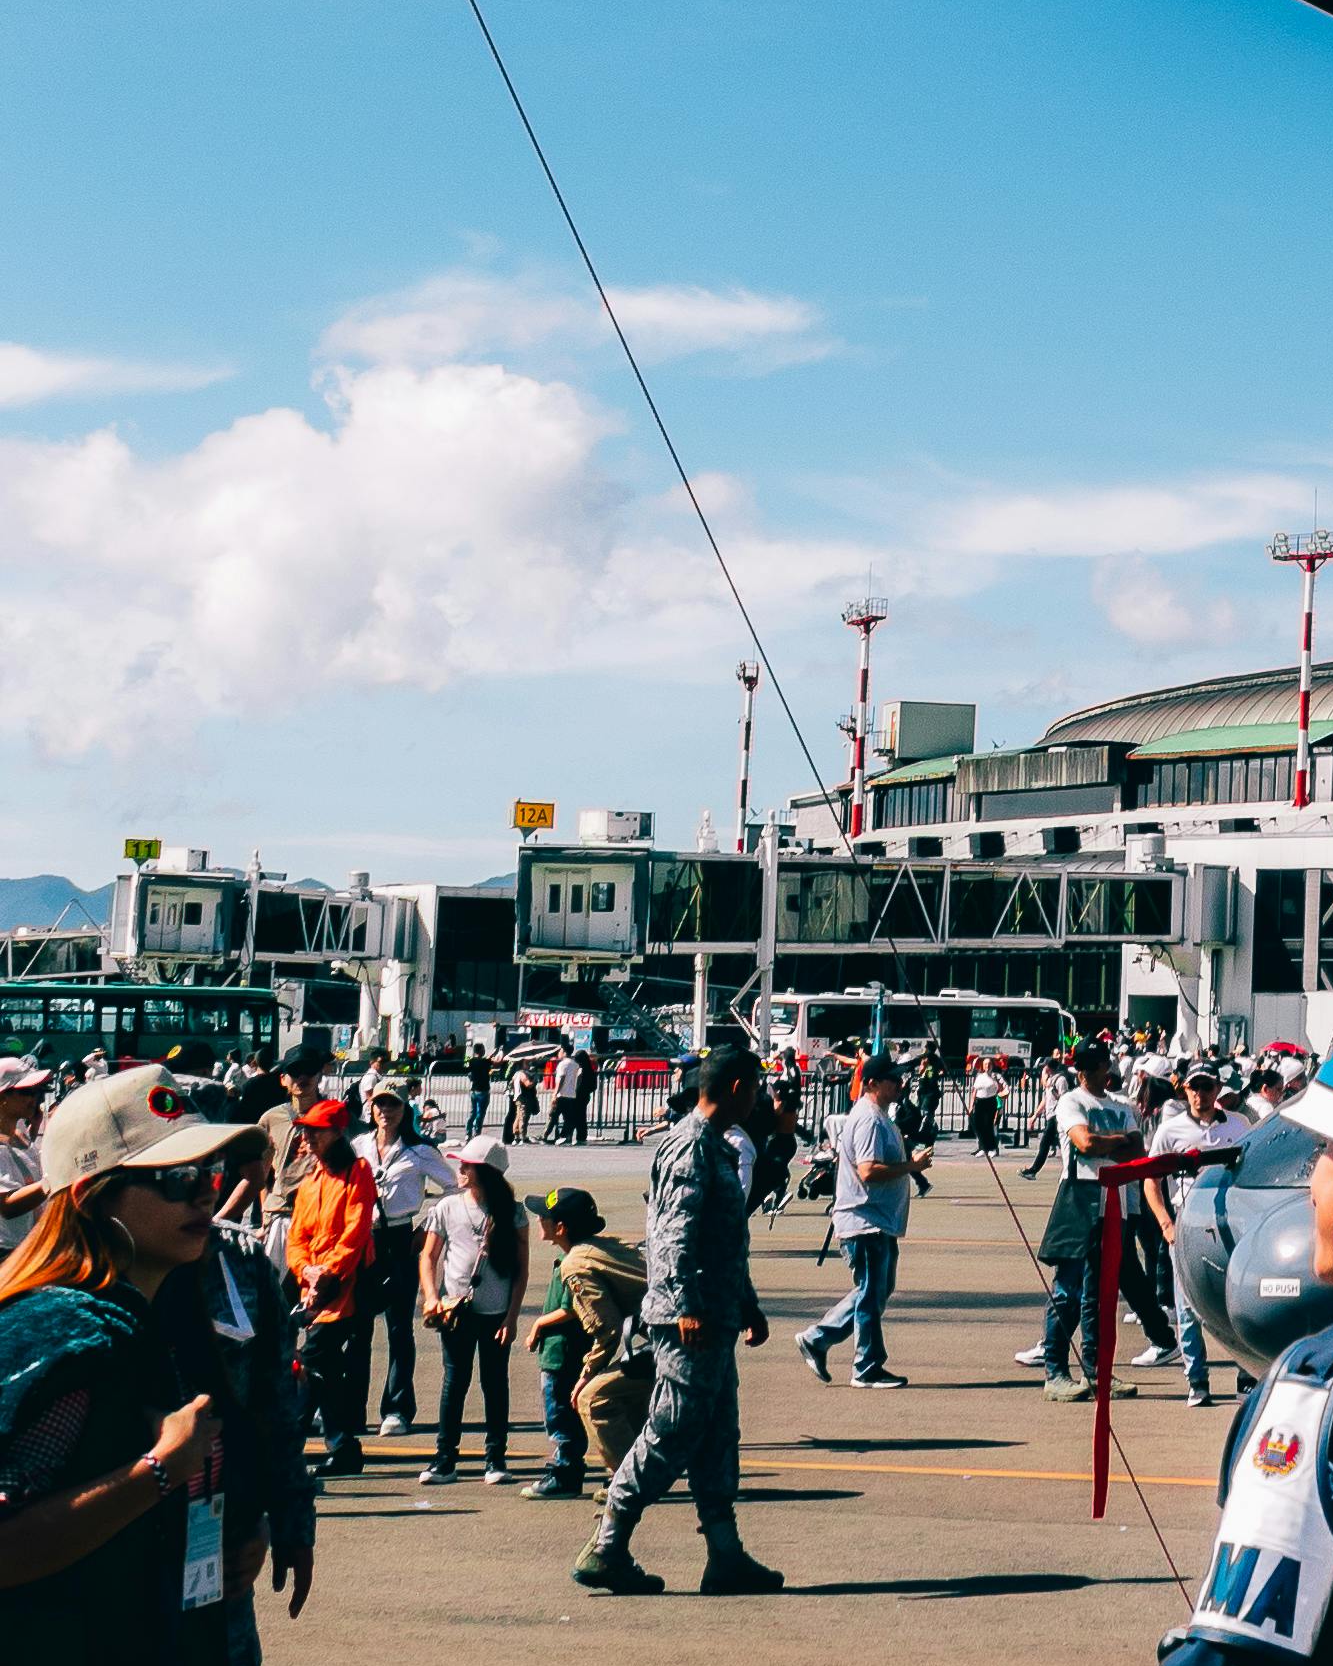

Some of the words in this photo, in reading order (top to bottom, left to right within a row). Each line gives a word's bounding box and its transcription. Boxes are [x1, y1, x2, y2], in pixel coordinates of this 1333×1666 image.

[520, 807, 548, 823] 12A
[133, 842, 153, 857] 11
[1276, 1284, 1298, 1294] PUSH
[1200, 1541, 1302, 1639] MA
